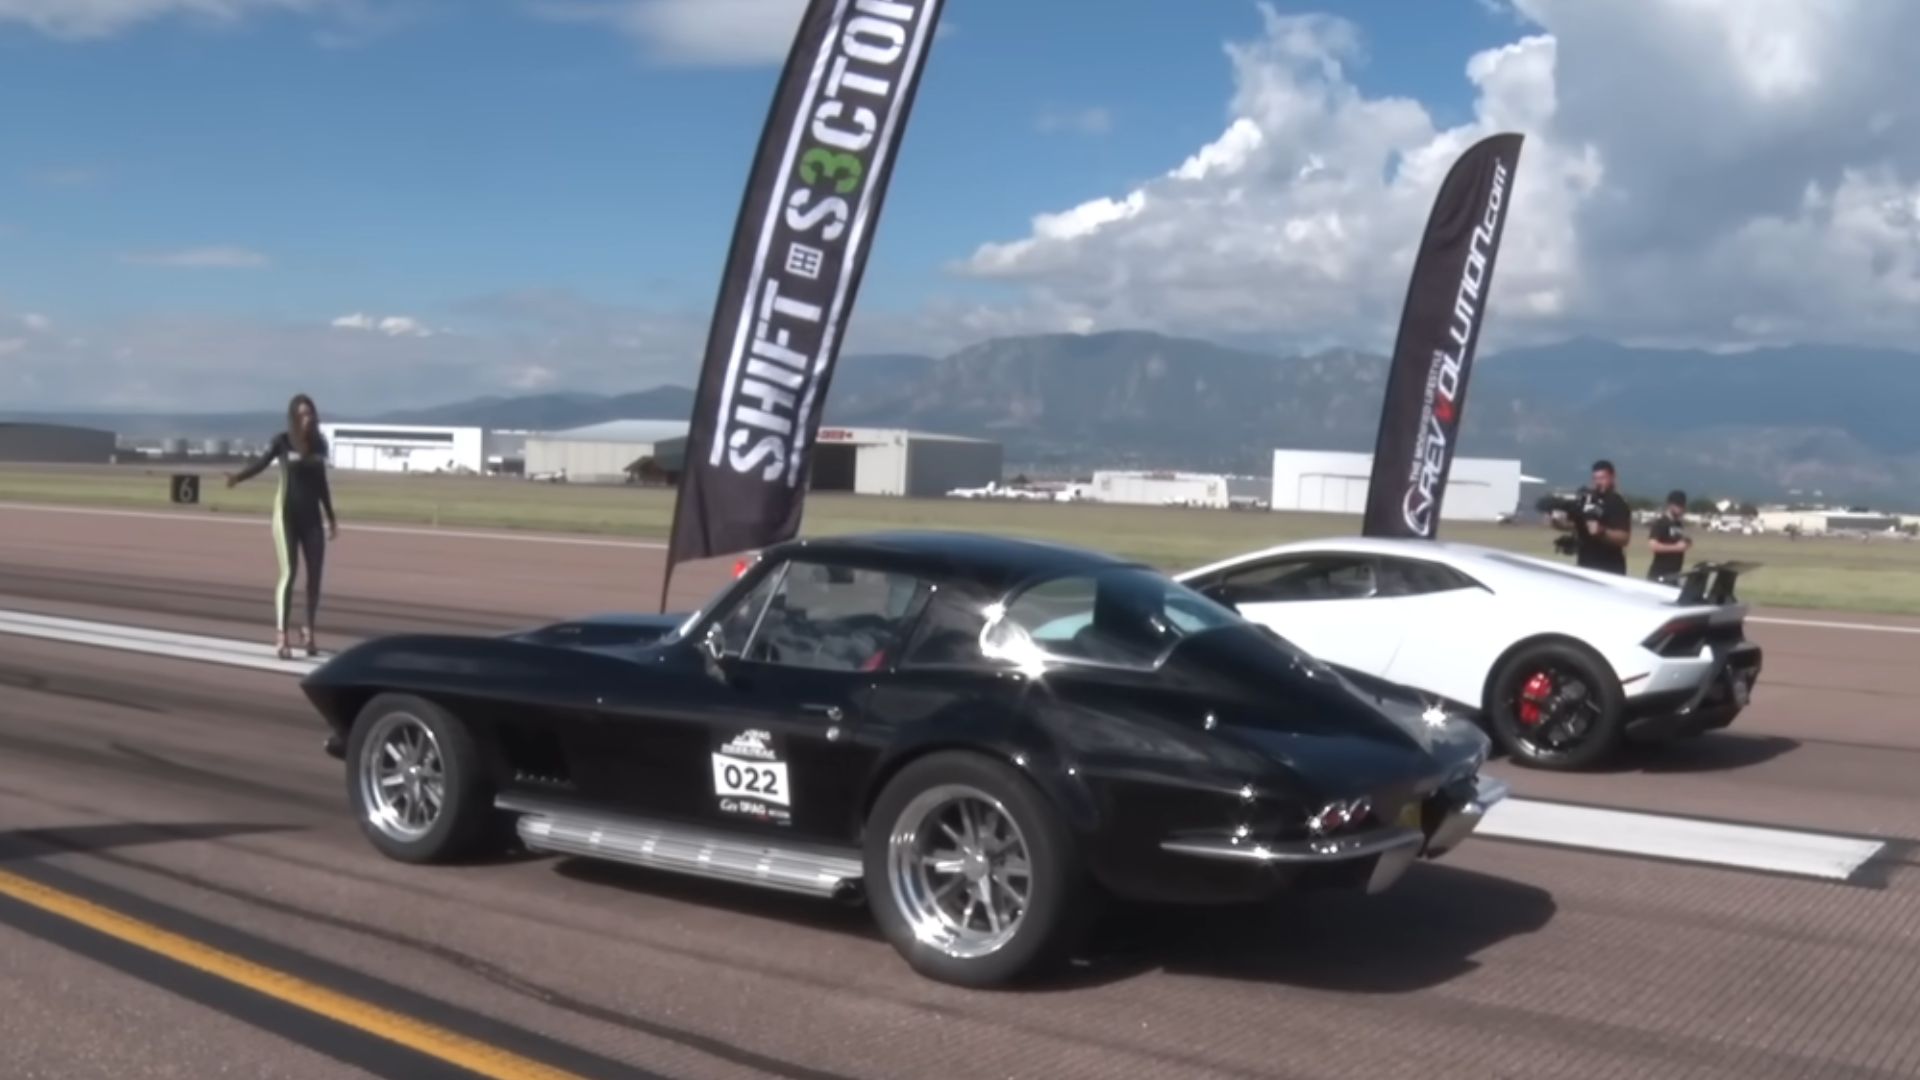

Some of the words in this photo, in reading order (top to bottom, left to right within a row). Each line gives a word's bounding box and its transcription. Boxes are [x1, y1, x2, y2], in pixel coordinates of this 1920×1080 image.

[728, 279, 822, 482] SHIFT
[1424, 349, 1444, 402] LIFESTYLE
[1414, 403, 1433, 459] MODIFIED
[179, 476, 194, 502] 6
[1408, 460, 1422, 482] THE
[724, 764, 779, 796] 022
